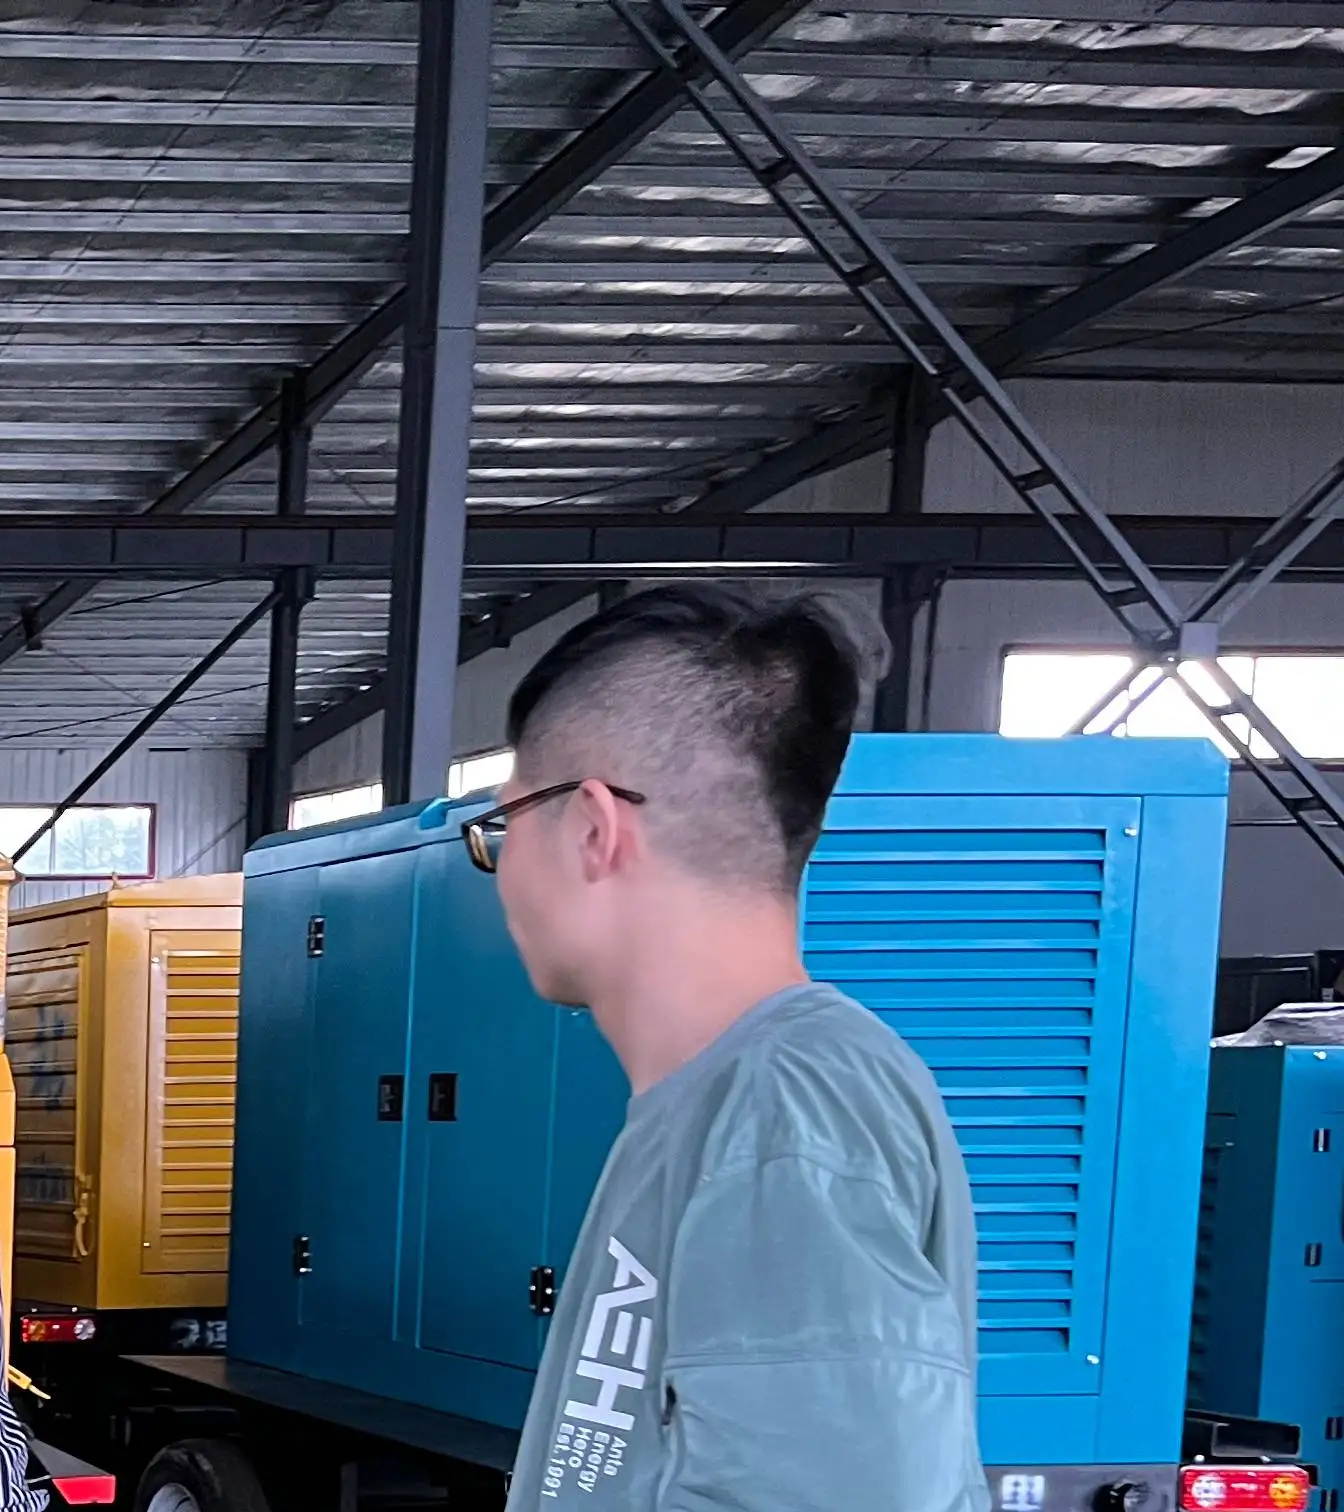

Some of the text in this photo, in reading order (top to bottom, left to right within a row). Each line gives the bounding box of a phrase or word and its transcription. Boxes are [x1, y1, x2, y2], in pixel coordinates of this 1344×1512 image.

[564, 1236, 658, 1430] AEH
[568, 1427, 592, 1468] Hero
[577, 1431, 610, 1492] Energy
